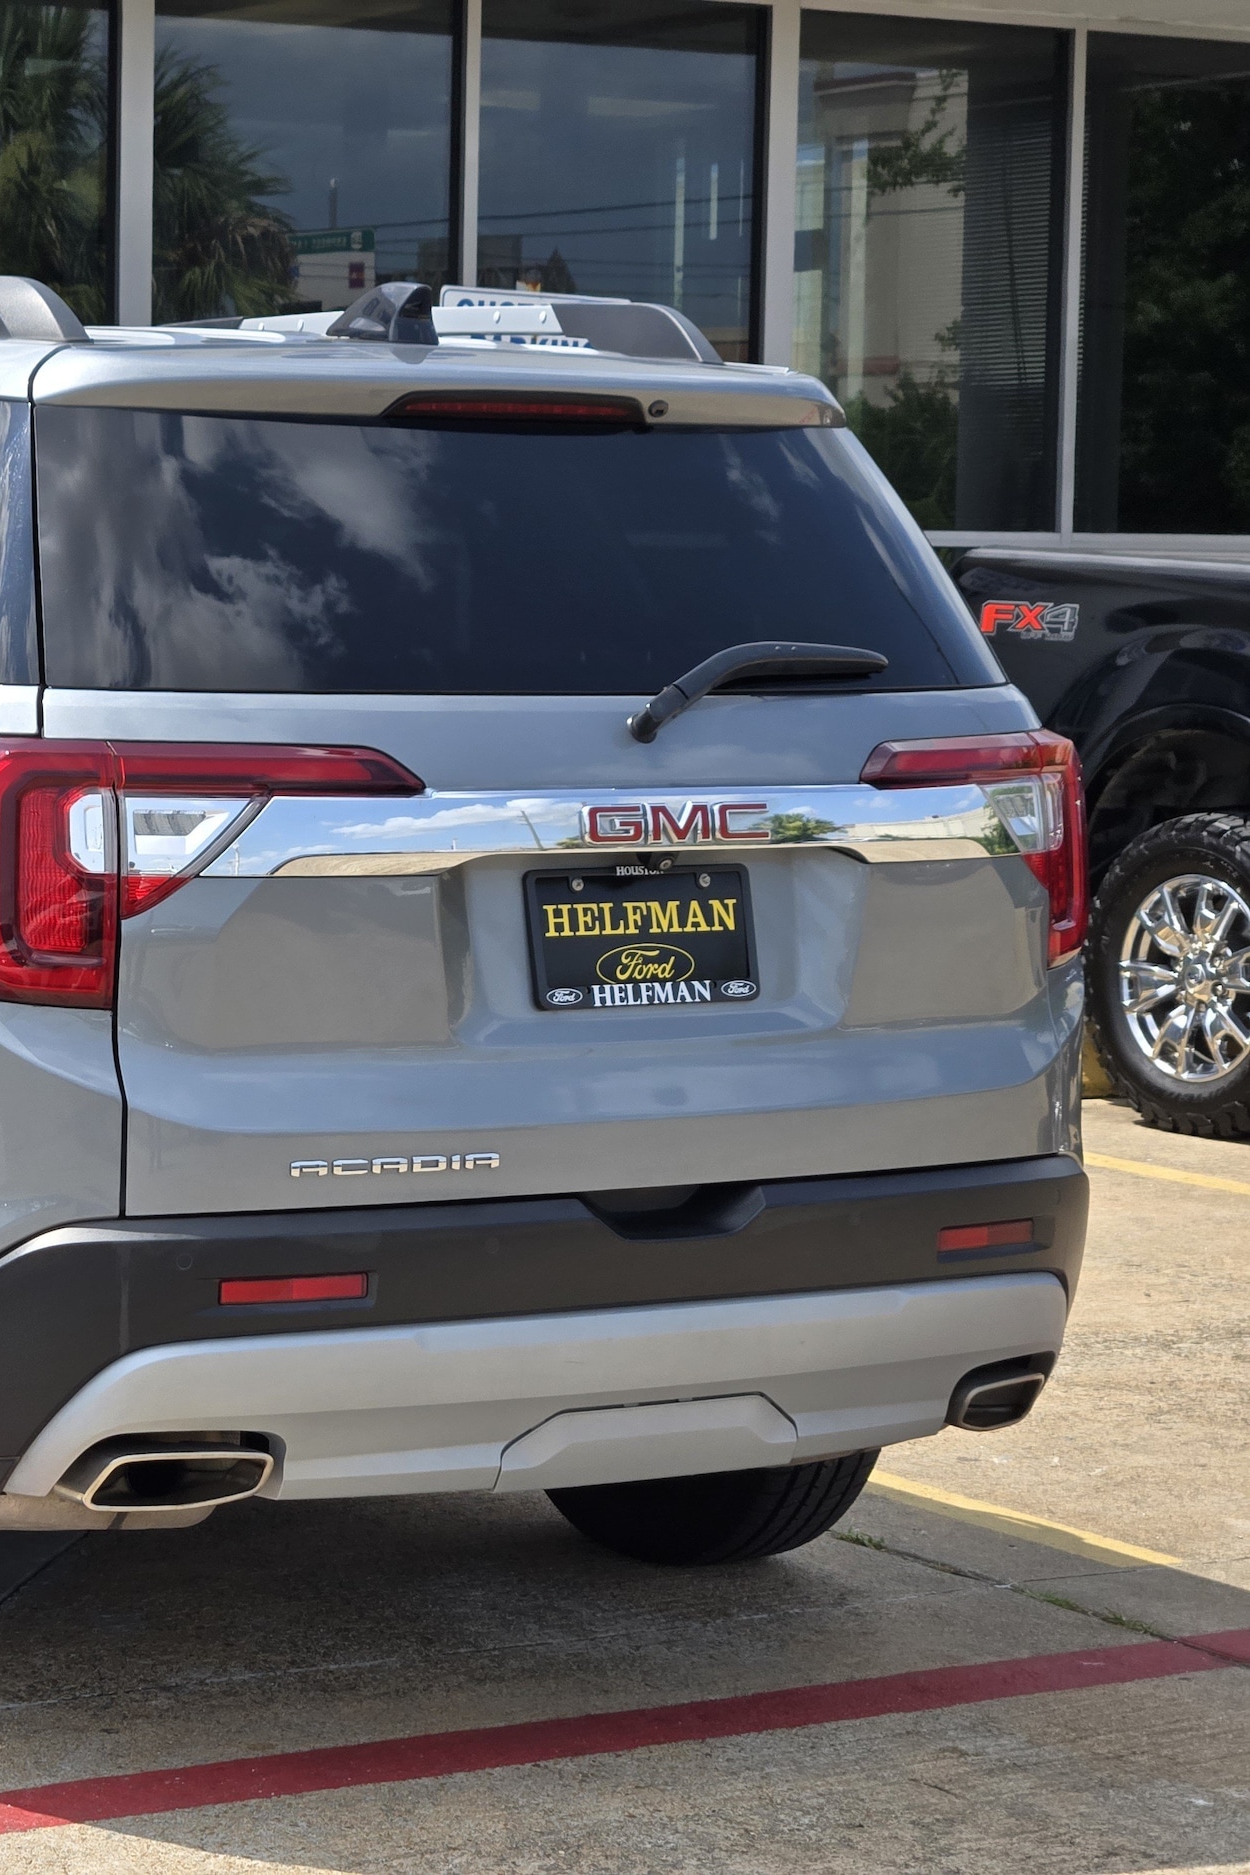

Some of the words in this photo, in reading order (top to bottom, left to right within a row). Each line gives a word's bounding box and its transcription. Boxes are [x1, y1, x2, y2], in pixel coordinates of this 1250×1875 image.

[980, 599, 1080, 635] FX4
[581, 800, 772, 846] GMC
[542, 898, 738, 938] HELFMAN
[615, 948, 676, 981] Ford
[552, 989, 577, 1003] Ford
[591, 979, 712, 1008] HELFMAN
[727, 981, 751, 995] Ford
[289, 1151, 501, 1179] ACADIA
